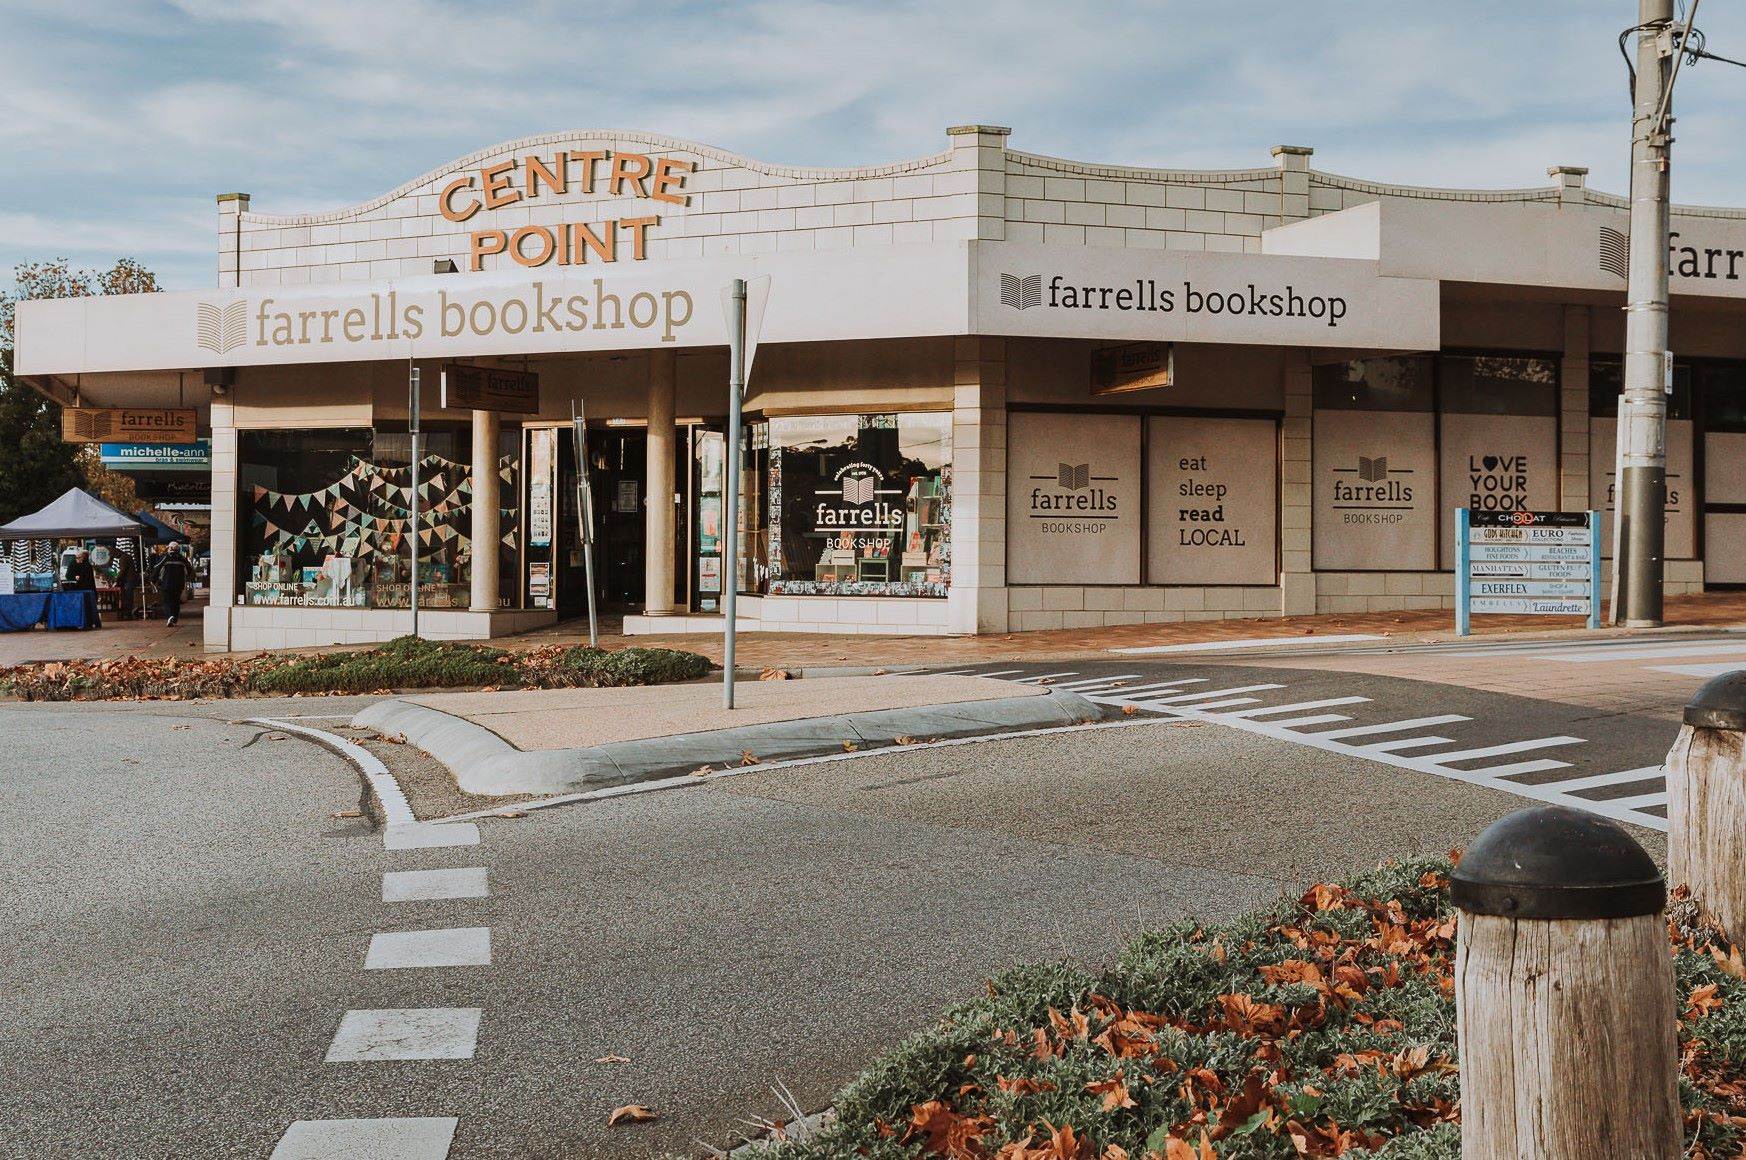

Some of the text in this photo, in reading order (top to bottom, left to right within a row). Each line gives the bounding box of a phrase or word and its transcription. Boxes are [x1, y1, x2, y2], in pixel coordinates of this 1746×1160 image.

[439, 150, 696, 222] CENTRE
[470, 215, 661, 272] POINT
[1048, 276, 1347, 327] farrells bookshop
[256, 278, 693, 346] farrells bookshop
[121, 412, 184, 426] farrells
[128, 433, 177, 442] BOOKSHOP
[120, 446, 205, 457] michelle-ann
[1179, 456, 1207, 471] eat
[1179, 479, 1227, 501] sleep
[1470, 474, 1527, 492] YOUR
[1030, 488, 1117, 511] farrells
[1334, 481, 1413, 502] farrells
[1470, 494, 1528, 511] BOOK
[816, 503, 903, 525] farrells
[1179, 505, 1225, 522] read
[1343, 513, 1404, 524] BOOKSHOP
[1042, 523, 1107, 534] BOOKSHOP
[1533, 530, 1564, 538] EURO
[826, 538, 891, 549] BOOKSHOP
[1179, 529, 1246, 546] LOCAL
[254, 583, 298, 591] SHOP ONLINE
[376, 584, 400, 592] SHOP
[1482, 584, 1528, 594] EXERFLEX
[1533, 603, 1583, 613] Laundrette
